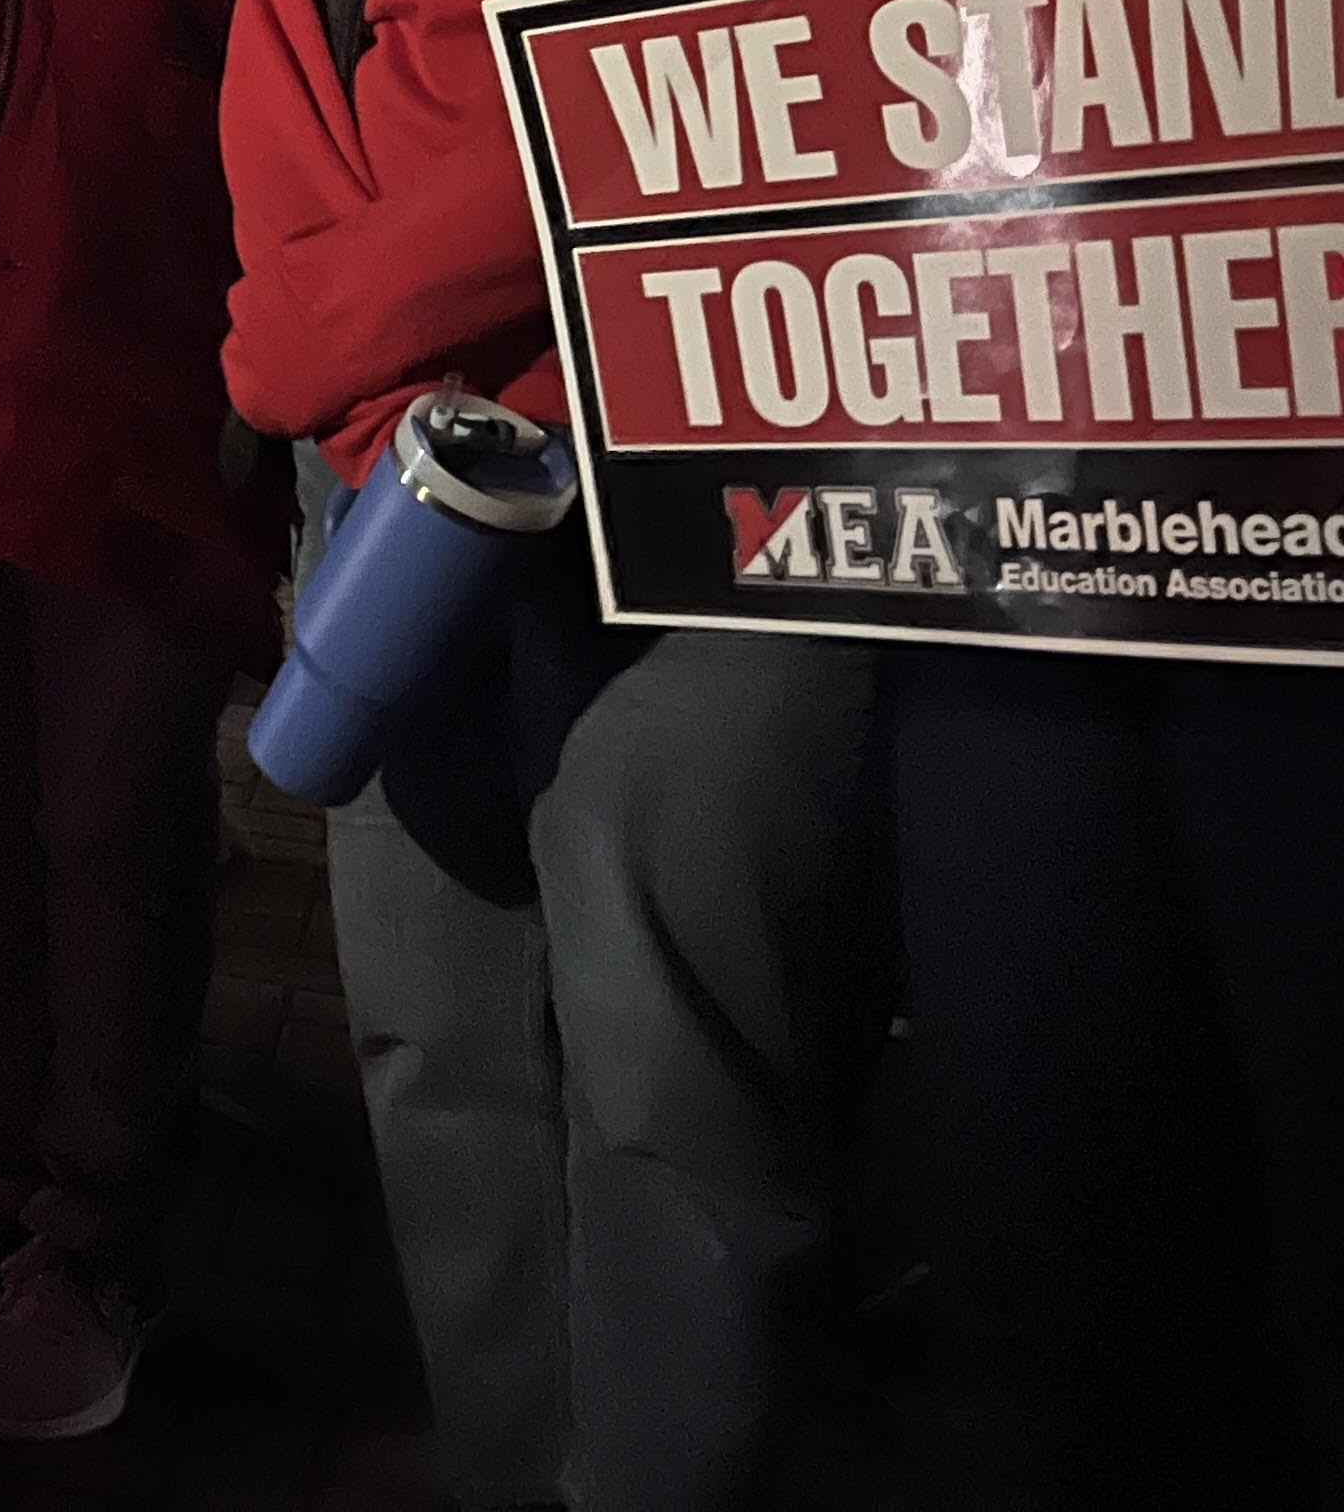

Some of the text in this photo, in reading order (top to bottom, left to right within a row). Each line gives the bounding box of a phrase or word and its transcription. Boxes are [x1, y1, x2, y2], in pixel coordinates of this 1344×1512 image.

[590, 14, 839, 196] WE
[643, 223, 1344, 428] TOGETHER
[724, 485, 967, 591] MEA
[1001, 562, 1344, 603] Education Associatio
